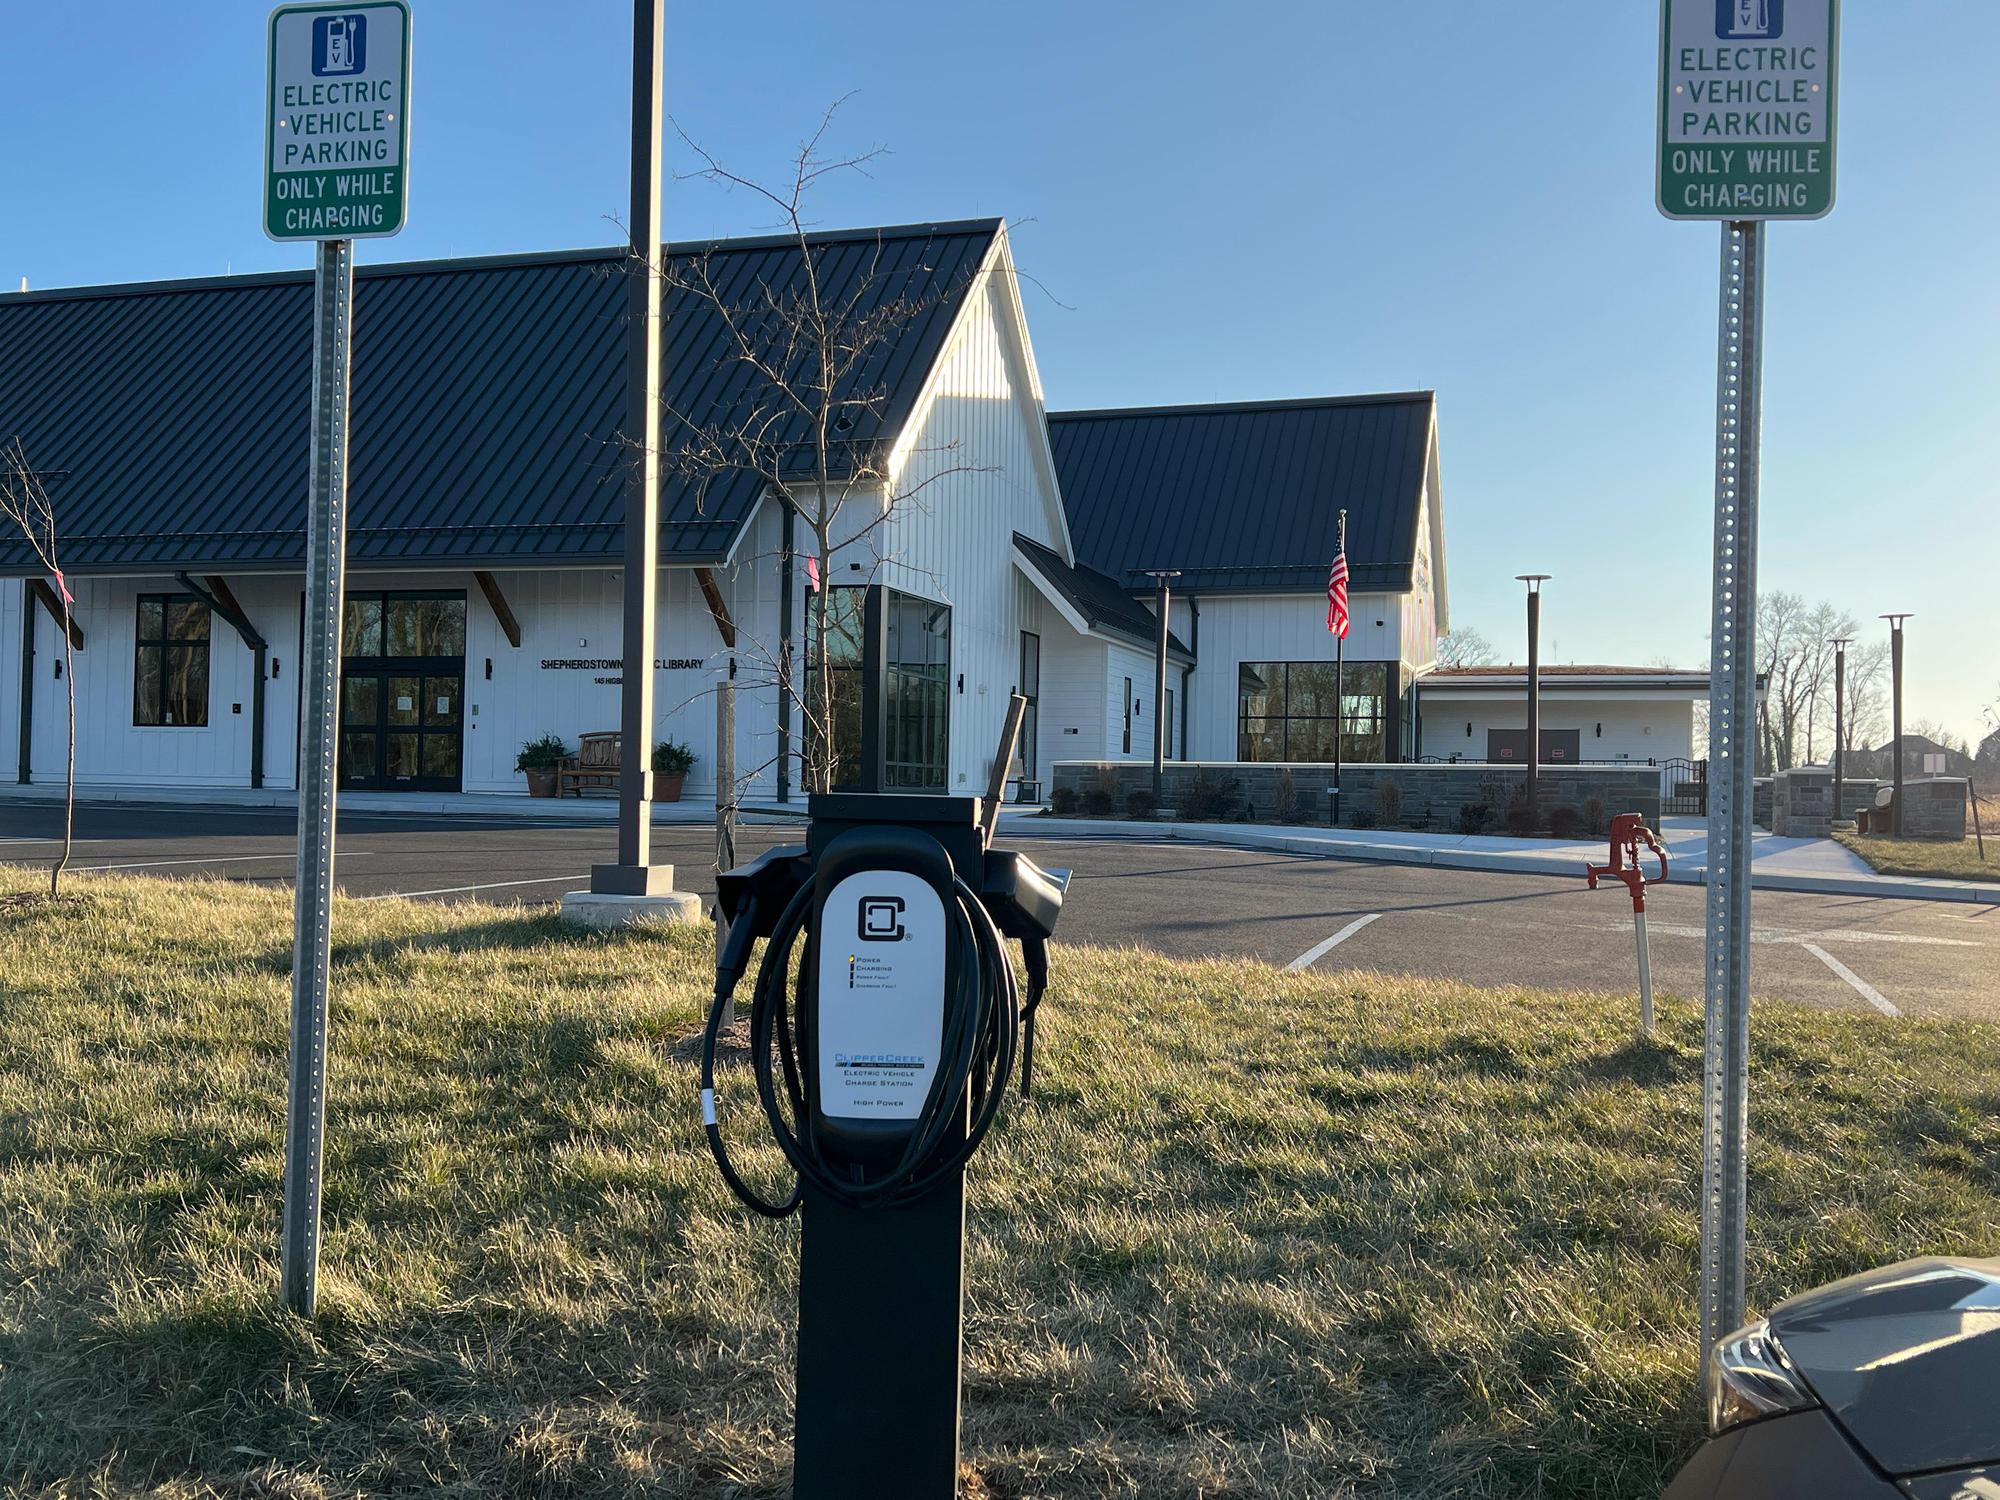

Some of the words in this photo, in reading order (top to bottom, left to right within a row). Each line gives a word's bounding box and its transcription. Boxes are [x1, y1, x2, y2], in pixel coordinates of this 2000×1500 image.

[1680, 47, 1817, 71] ELECTRIC
[284, 80, 392, 107] ELECTRIC
[1688, 80, 1808, 104] VEHICLE
[290, 110, 385, 135] VEHICLE
[1682, 112, 1812, 136] PARKING
[285, 139, 388, 165] PARKING
[1672, 150, 1735, 174] ONLY
[1747, 149, 1821, 173] WHILE
[277, 177, 327, 200] ONLY
[336, 173, 395, 197] WHILE
[1684, 184, 1808, 207] CHARGING
[286, 204, 383, 229] CHARGING
[541, 659, 624, 669] SHEPHERDSTOWN
[662, 659, 703, 669] LIBRARY
